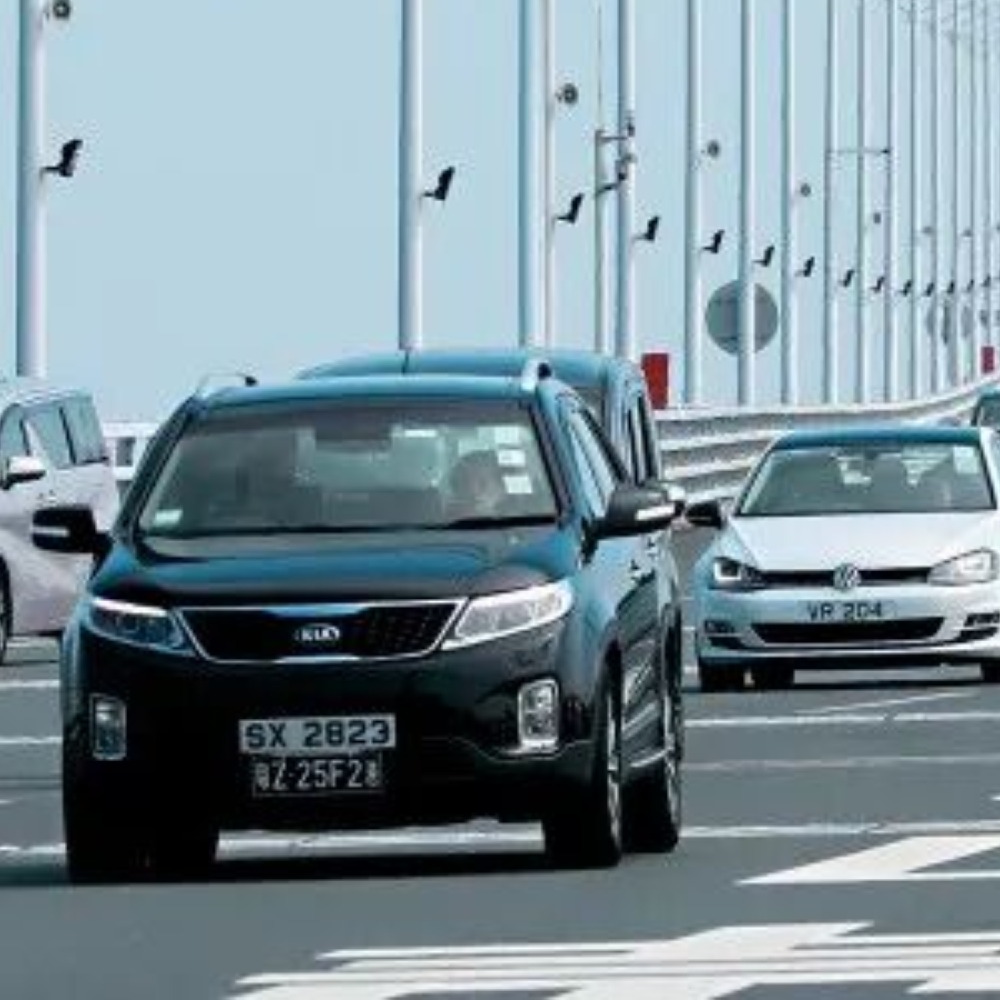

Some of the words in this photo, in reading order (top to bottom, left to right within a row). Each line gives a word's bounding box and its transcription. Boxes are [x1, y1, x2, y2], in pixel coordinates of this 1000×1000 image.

[299, 626, 338, 642] KIA
[244, 722, 287, 748] SX
[303, 719, 391, 747] 2823
